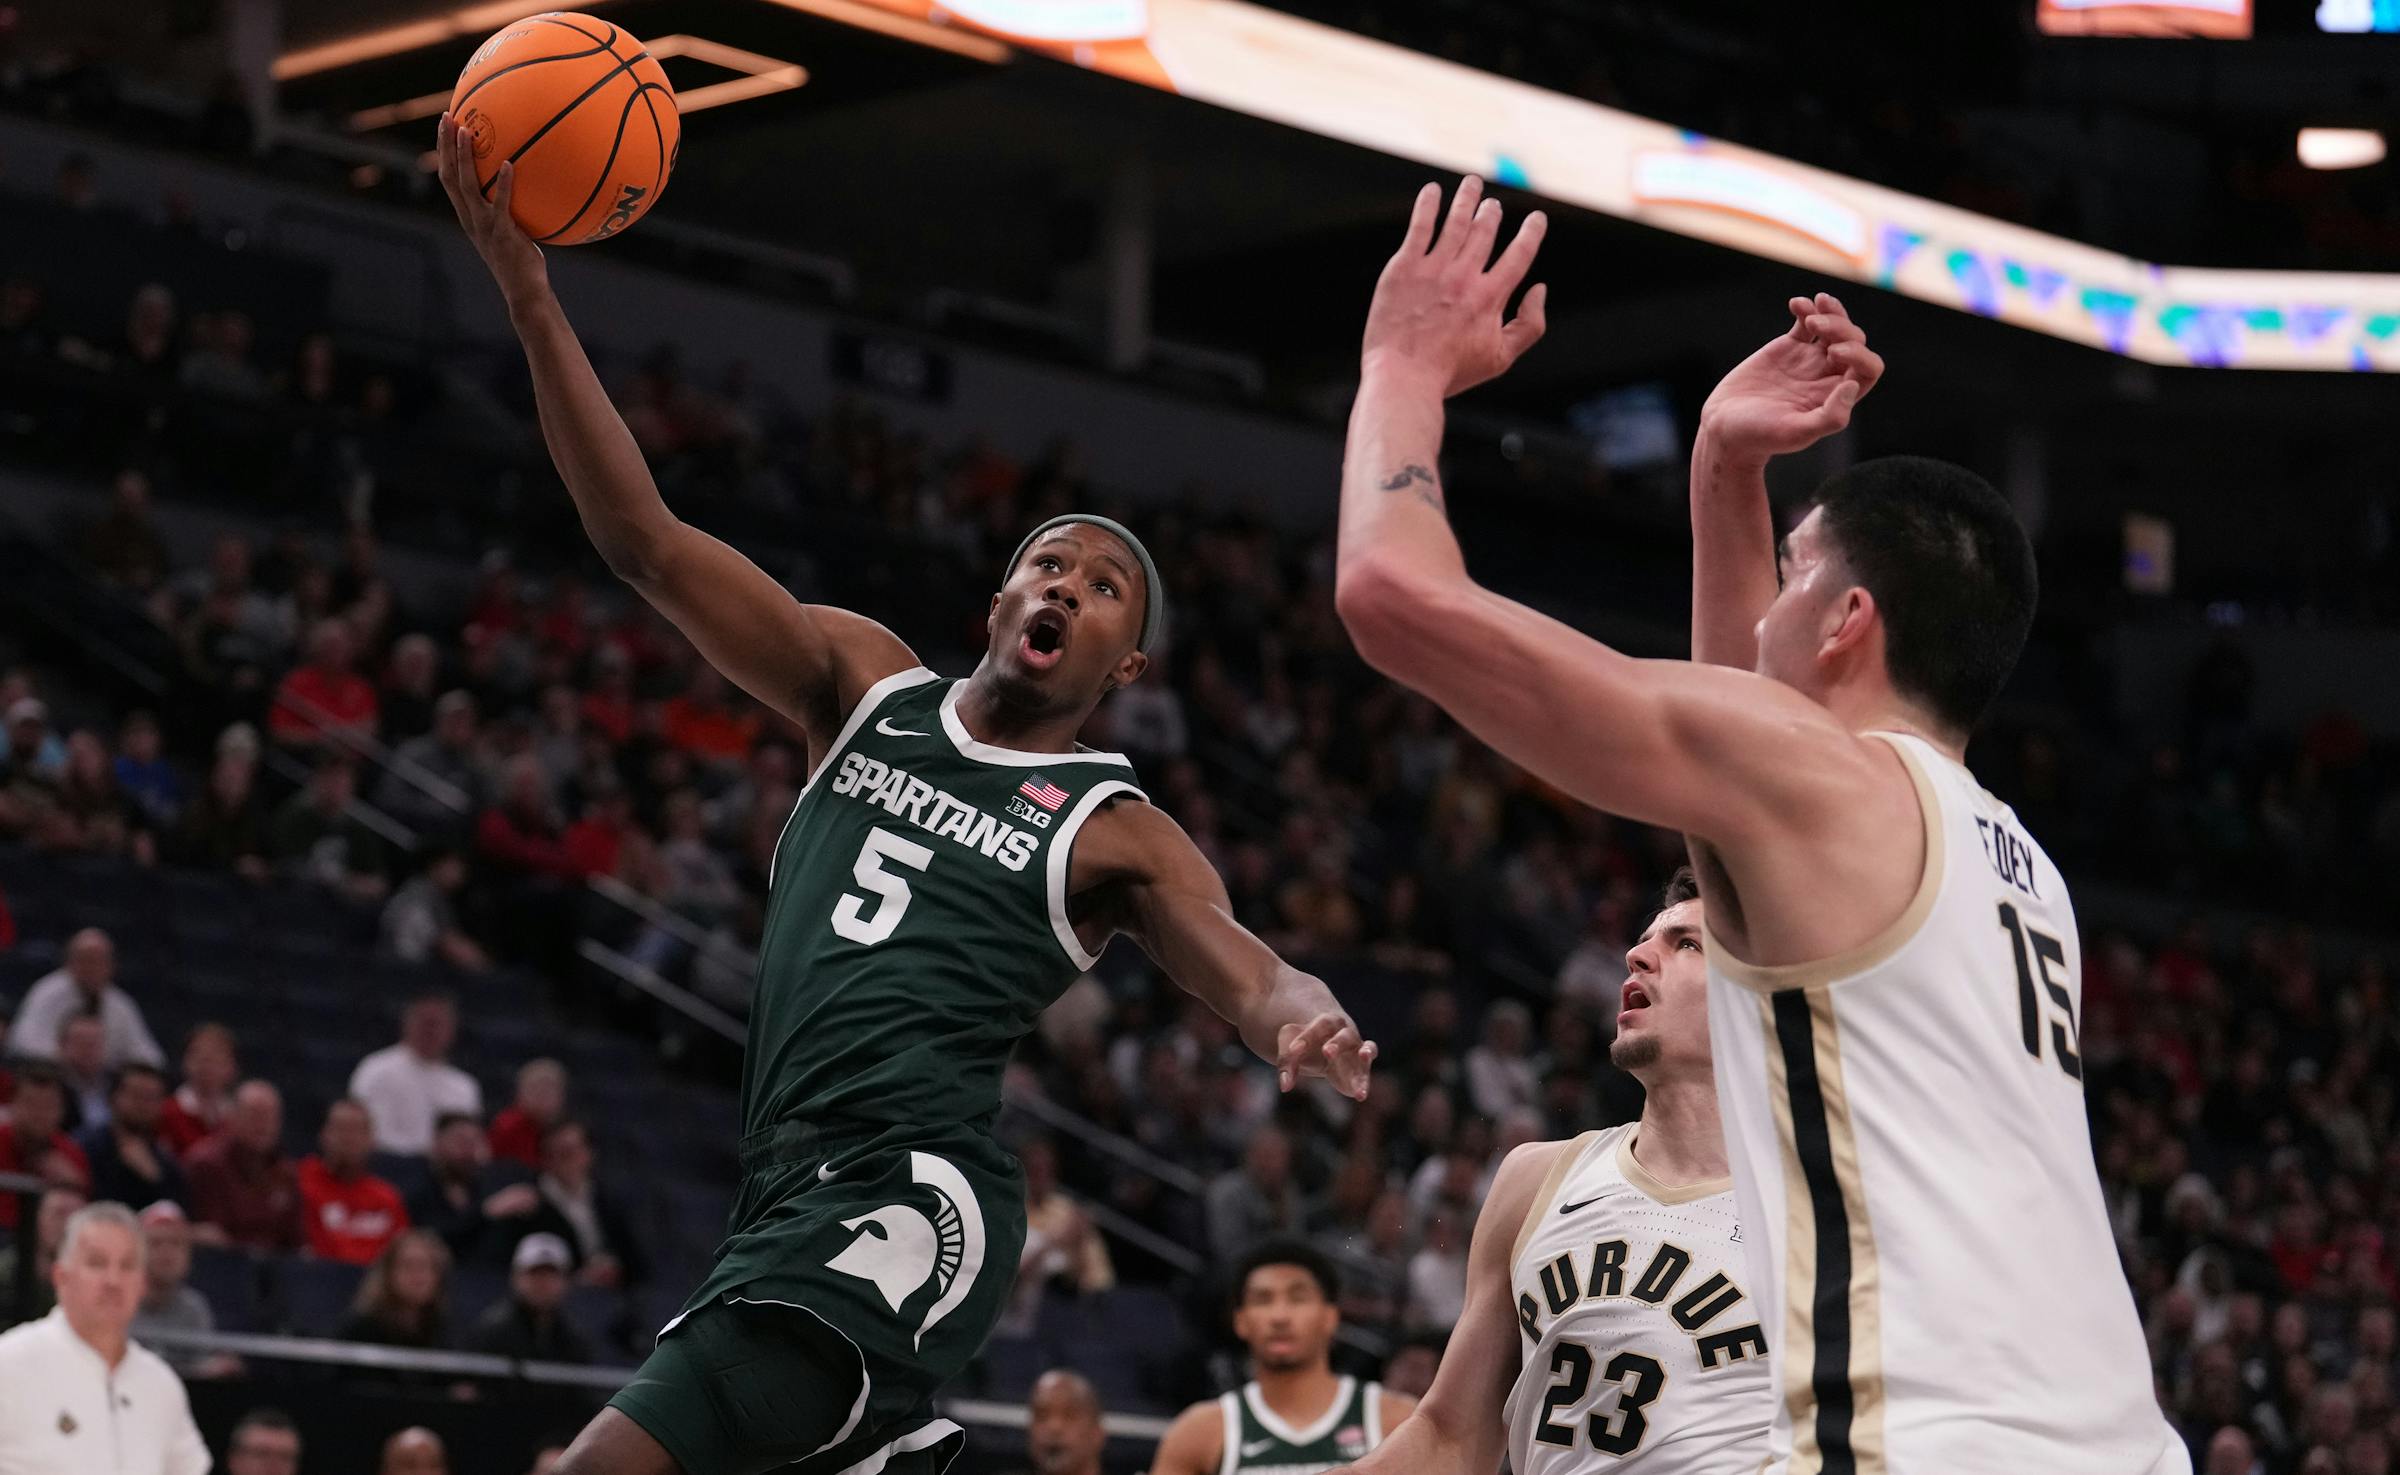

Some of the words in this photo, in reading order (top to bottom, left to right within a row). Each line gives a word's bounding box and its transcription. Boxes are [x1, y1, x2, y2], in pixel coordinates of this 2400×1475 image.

[831, 751, 1040, 872] SPARTANS
[830, 826, 935, 946] 5
[1997, 900, 2081, 1082] 15
[1518, 1239, 1769, 1371] PURDUE
[1535, 1339, 1669, 1457] 23
